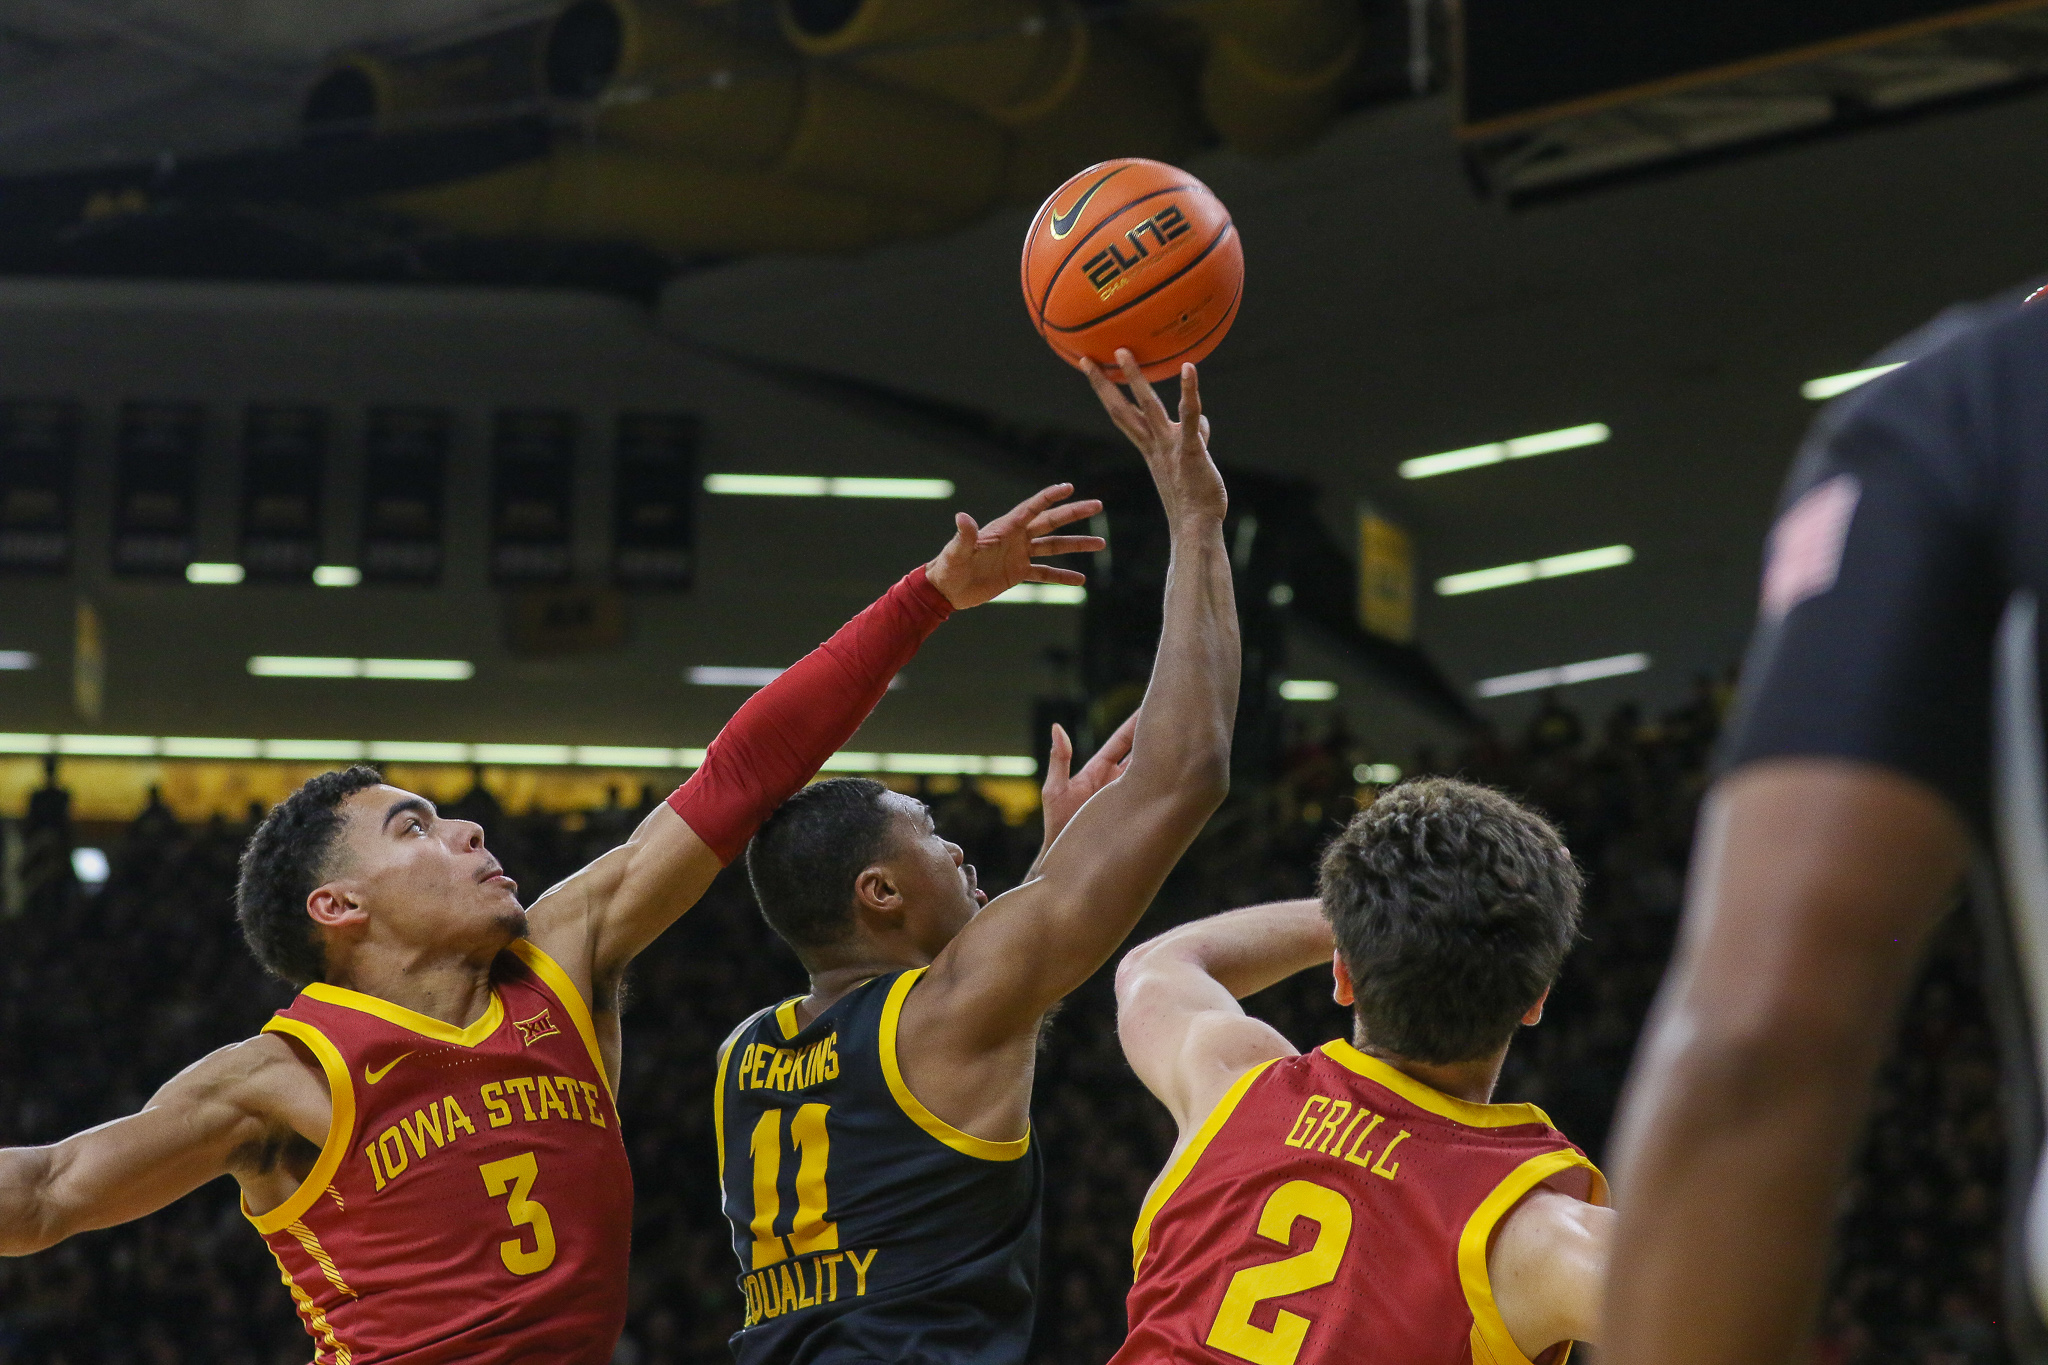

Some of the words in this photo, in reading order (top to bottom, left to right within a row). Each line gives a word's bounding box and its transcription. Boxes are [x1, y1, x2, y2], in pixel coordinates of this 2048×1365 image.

[739, 1032, 839, 1092] PERKINS
[365, 1095, 475, 1192] IOWA
[480, 1075, 606, 1129] STATE
[750, 1103, 839, 1271] 11
[1285, 1094, 1411, 1180] GRILL
[479, 1151, 556, 1276] 3
[1205, 1180, 1352, 1365] 2
